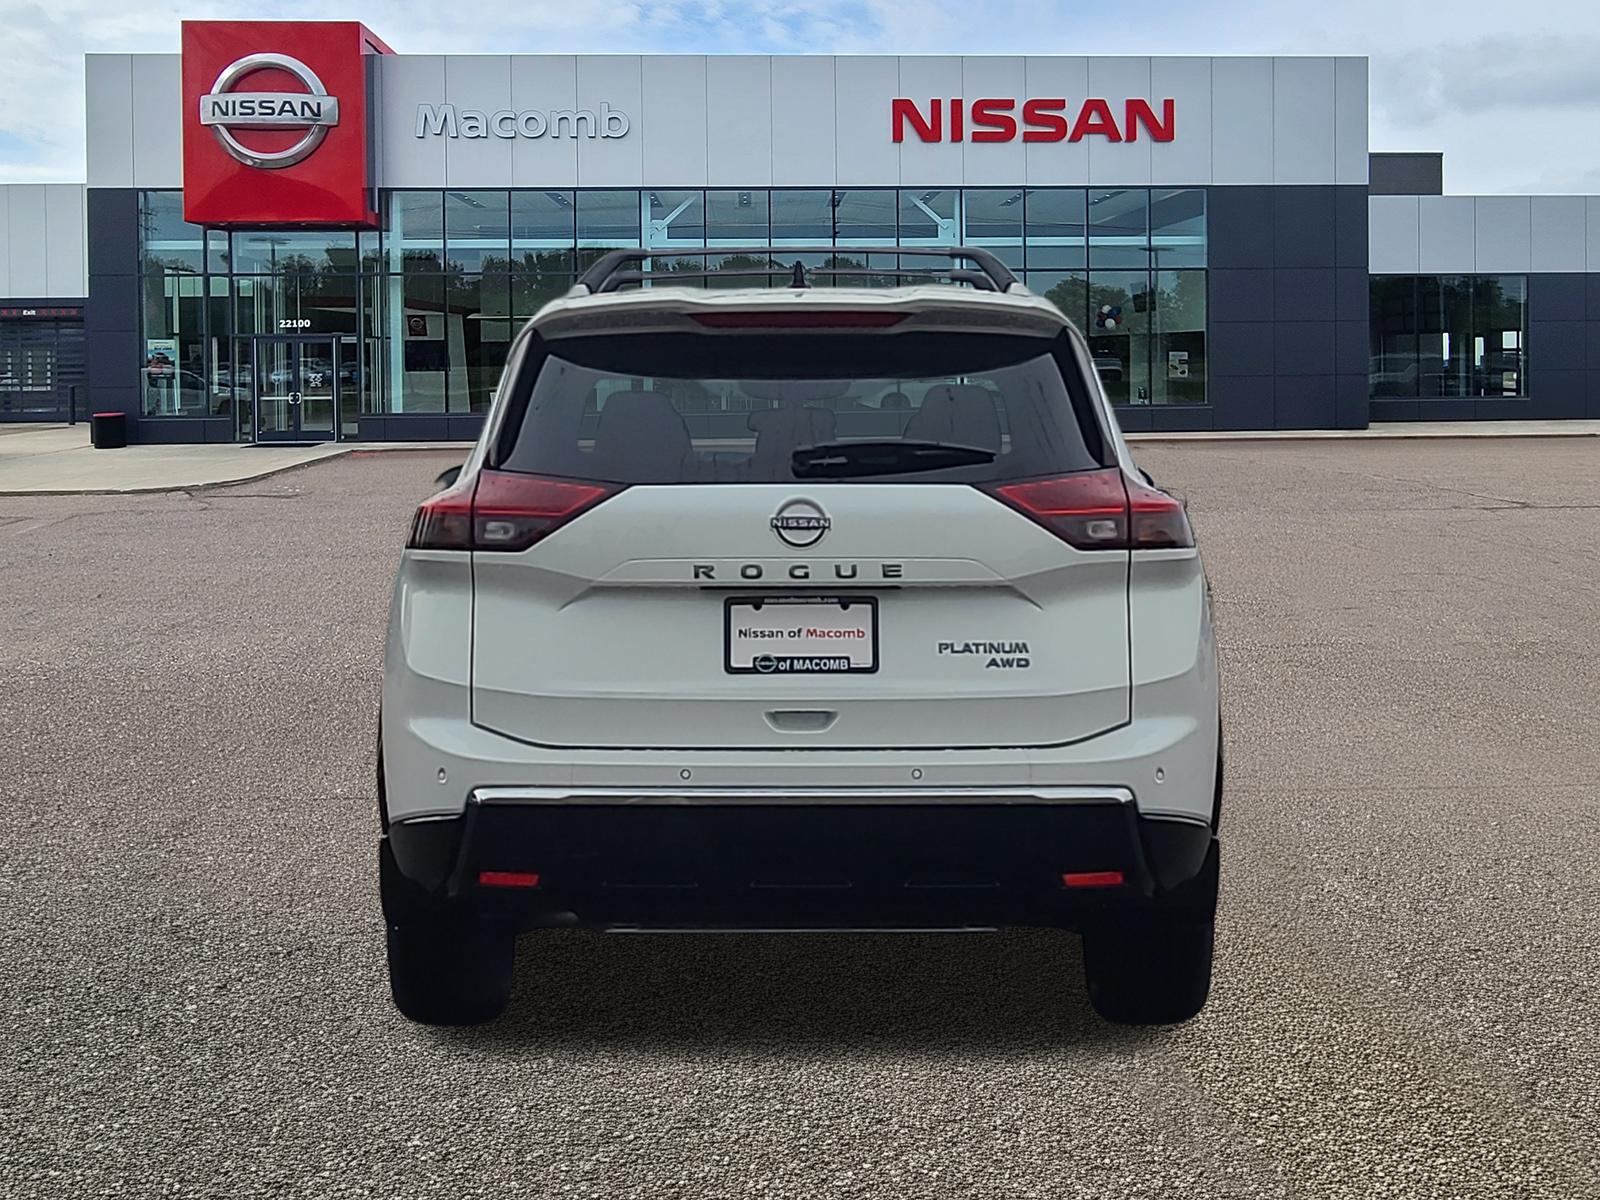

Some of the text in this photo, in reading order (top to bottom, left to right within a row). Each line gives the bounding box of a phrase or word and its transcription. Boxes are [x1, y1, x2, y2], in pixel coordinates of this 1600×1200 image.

[211, 100, 322, 118] NISSAN
[415, 102, 630, 139] Macomb
[893, 98, 1175, 143] NISSAN
[279, 319, 311, 329] 22100
[771, 518, 831, 529] NISSAN
[692, 564, 903, 580] ROGUE
[737, 627, 866, 639] Nissan of Macomb
[937, 641, 1030, 655] PLATINUM
[778, 658, 849, 671] of MACOMB
[985, 657, 1031, 669] AWD
